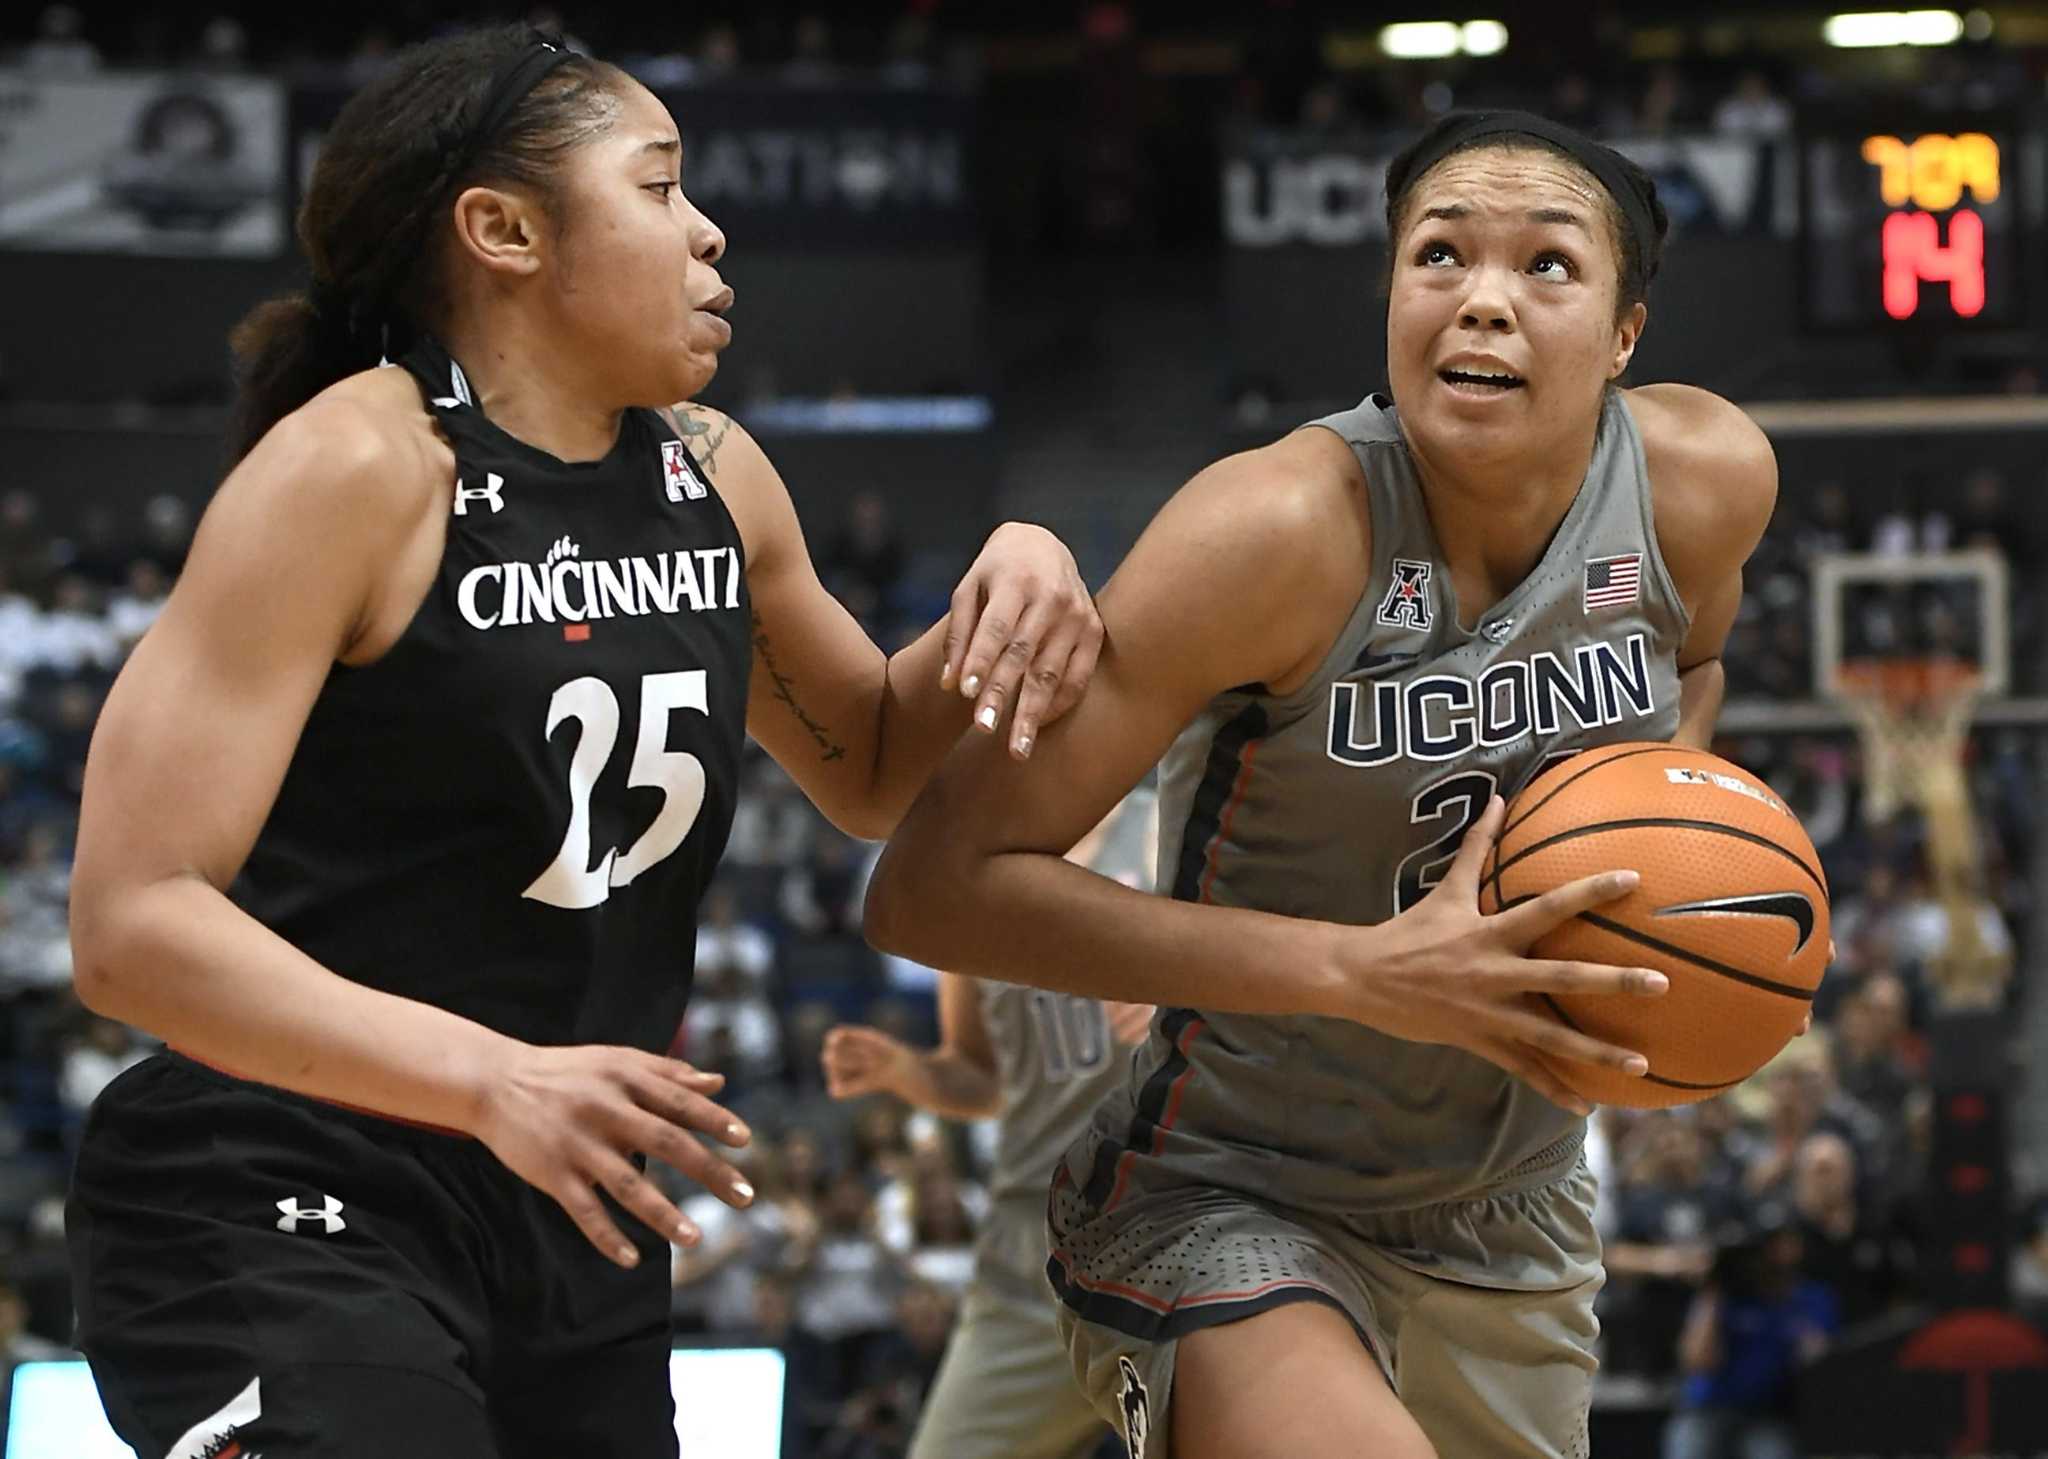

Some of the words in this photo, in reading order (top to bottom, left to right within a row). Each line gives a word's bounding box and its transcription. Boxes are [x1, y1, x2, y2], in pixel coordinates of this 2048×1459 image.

[1882, 208, 1985, 320] 14
[457, 546, 740, 630] CINCINNATI
[1377, 558, 1433, 632] A
[1326, 633, 1655, 767] UCONN
[521, 669, 709, 910] 25
